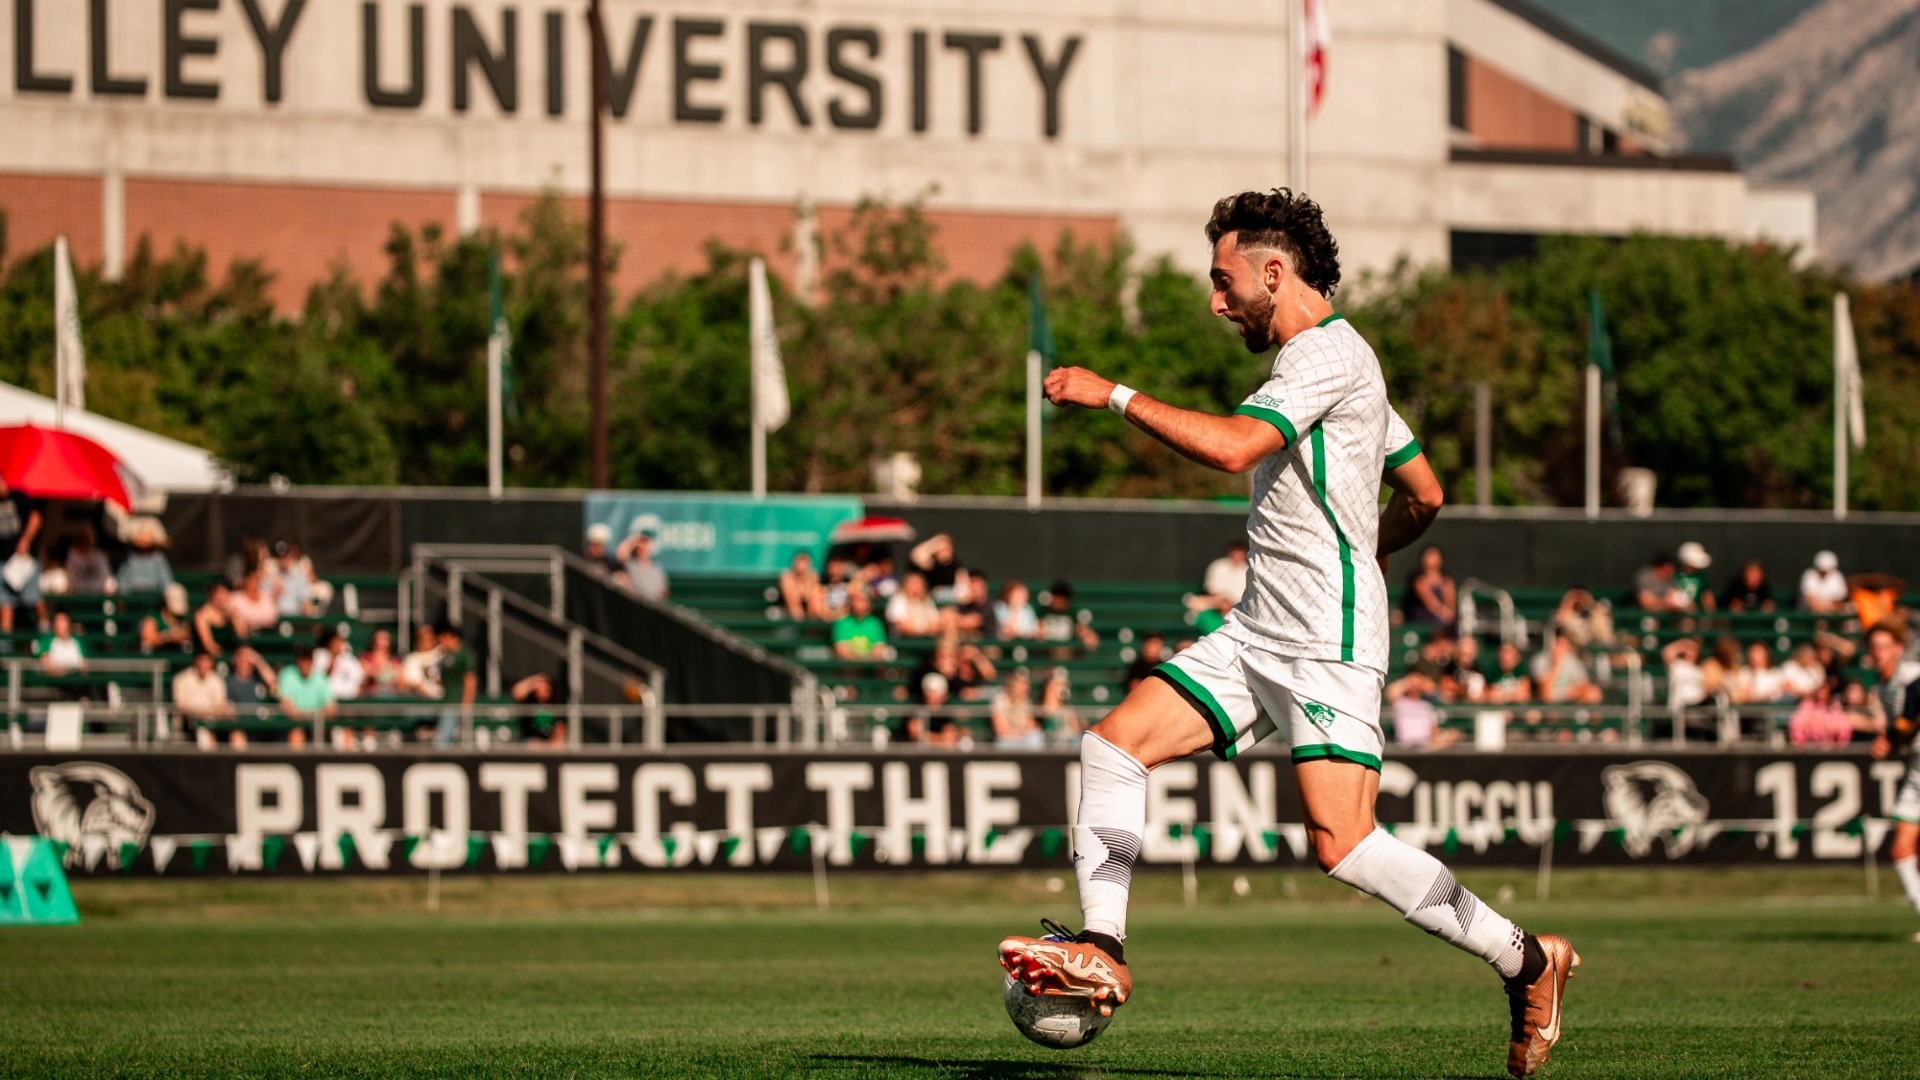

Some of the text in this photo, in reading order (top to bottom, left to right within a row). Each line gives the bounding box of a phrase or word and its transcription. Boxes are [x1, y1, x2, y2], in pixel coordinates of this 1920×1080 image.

[362, 2, 1084, 138] UNIVERSITY
[235, 762, 773, 870] PROTECT
[805, 761, 1023, 867] THE
